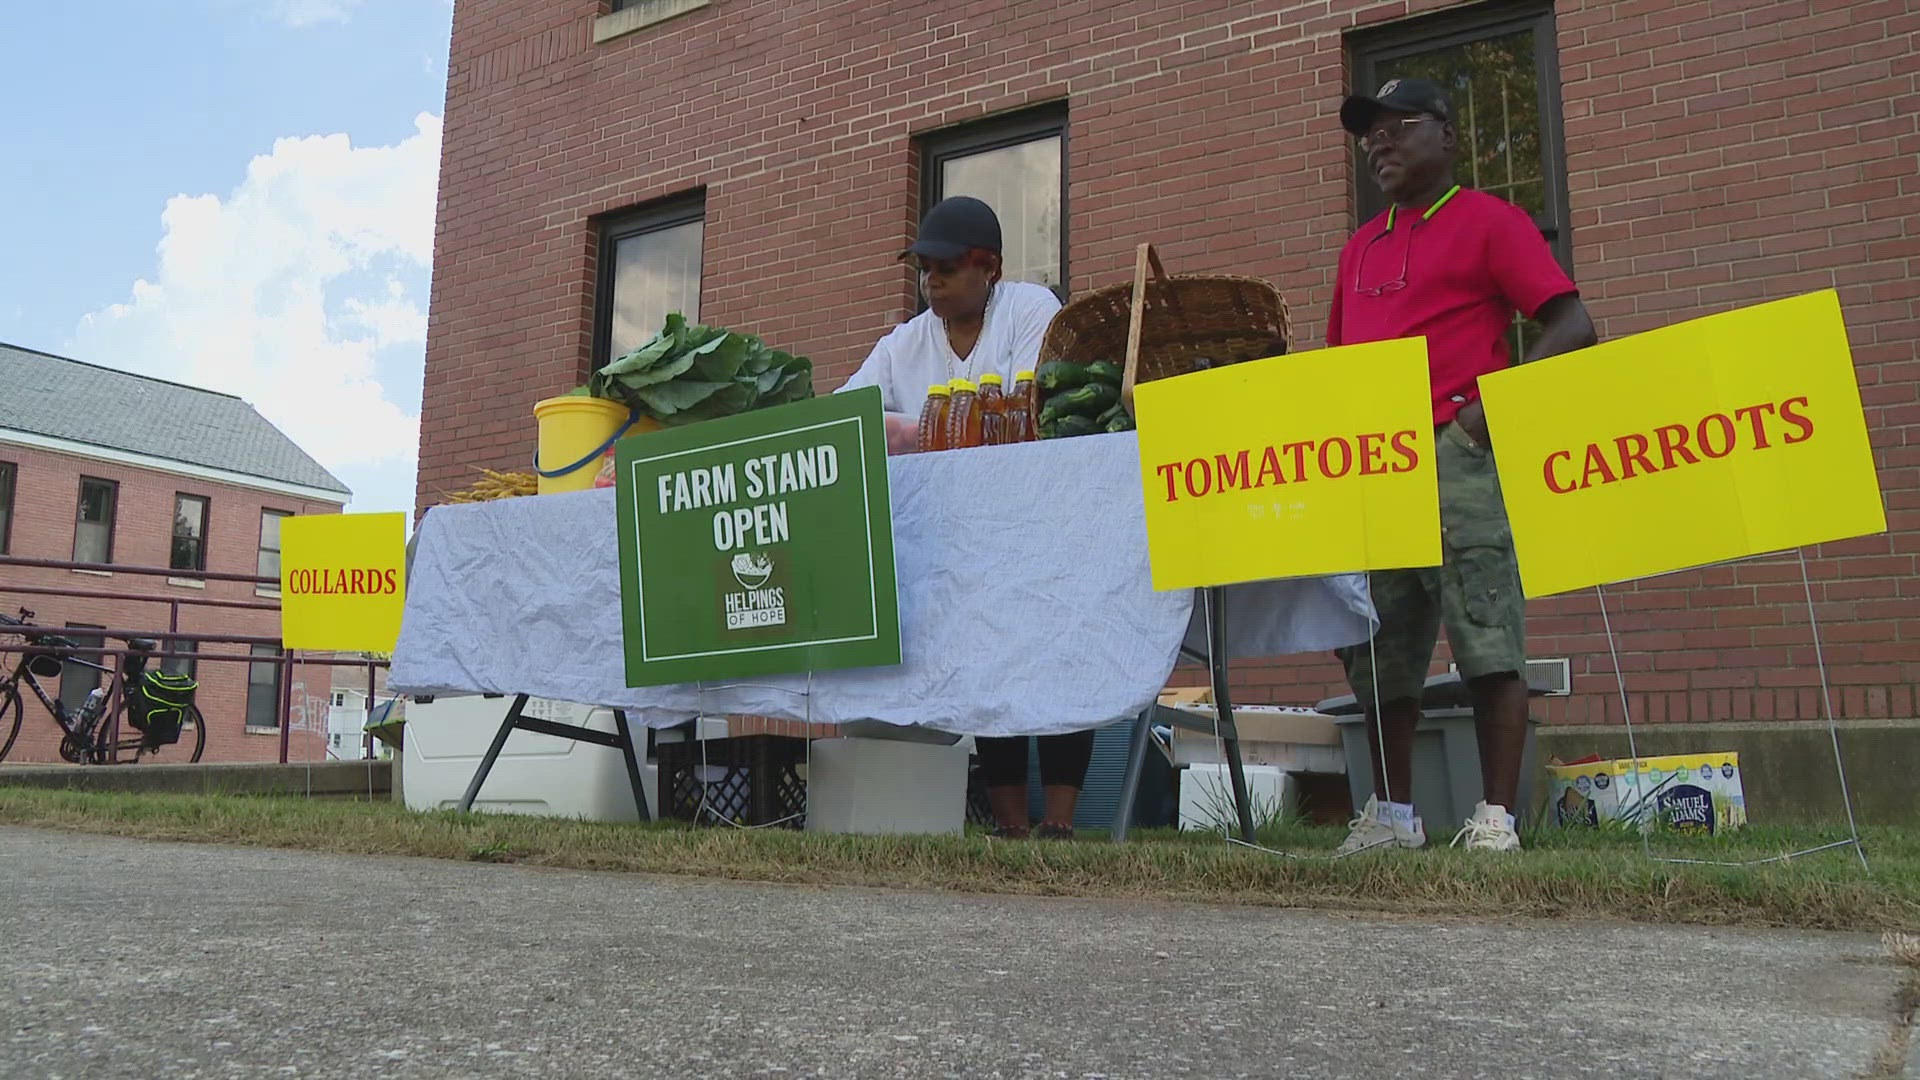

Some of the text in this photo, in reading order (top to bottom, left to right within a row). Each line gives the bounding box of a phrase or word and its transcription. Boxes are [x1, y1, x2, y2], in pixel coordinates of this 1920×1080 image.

[1543, 396, 1814, 494] CARROTS
[1157, 430, 1419, 502] TOMATOES
[658, 444, 838, 514] FARM STAND
[713, 501, 789, 552] OPEN
[290, 569, 397, 594] COLLARDS
[725, 587, 784, 612] HELPINGS
[729, 609, 784, 626] OF HOPE
[1663, 794, 1709, 810] SAMUEL
[1668, 808, 1707, 823] ADAMS
